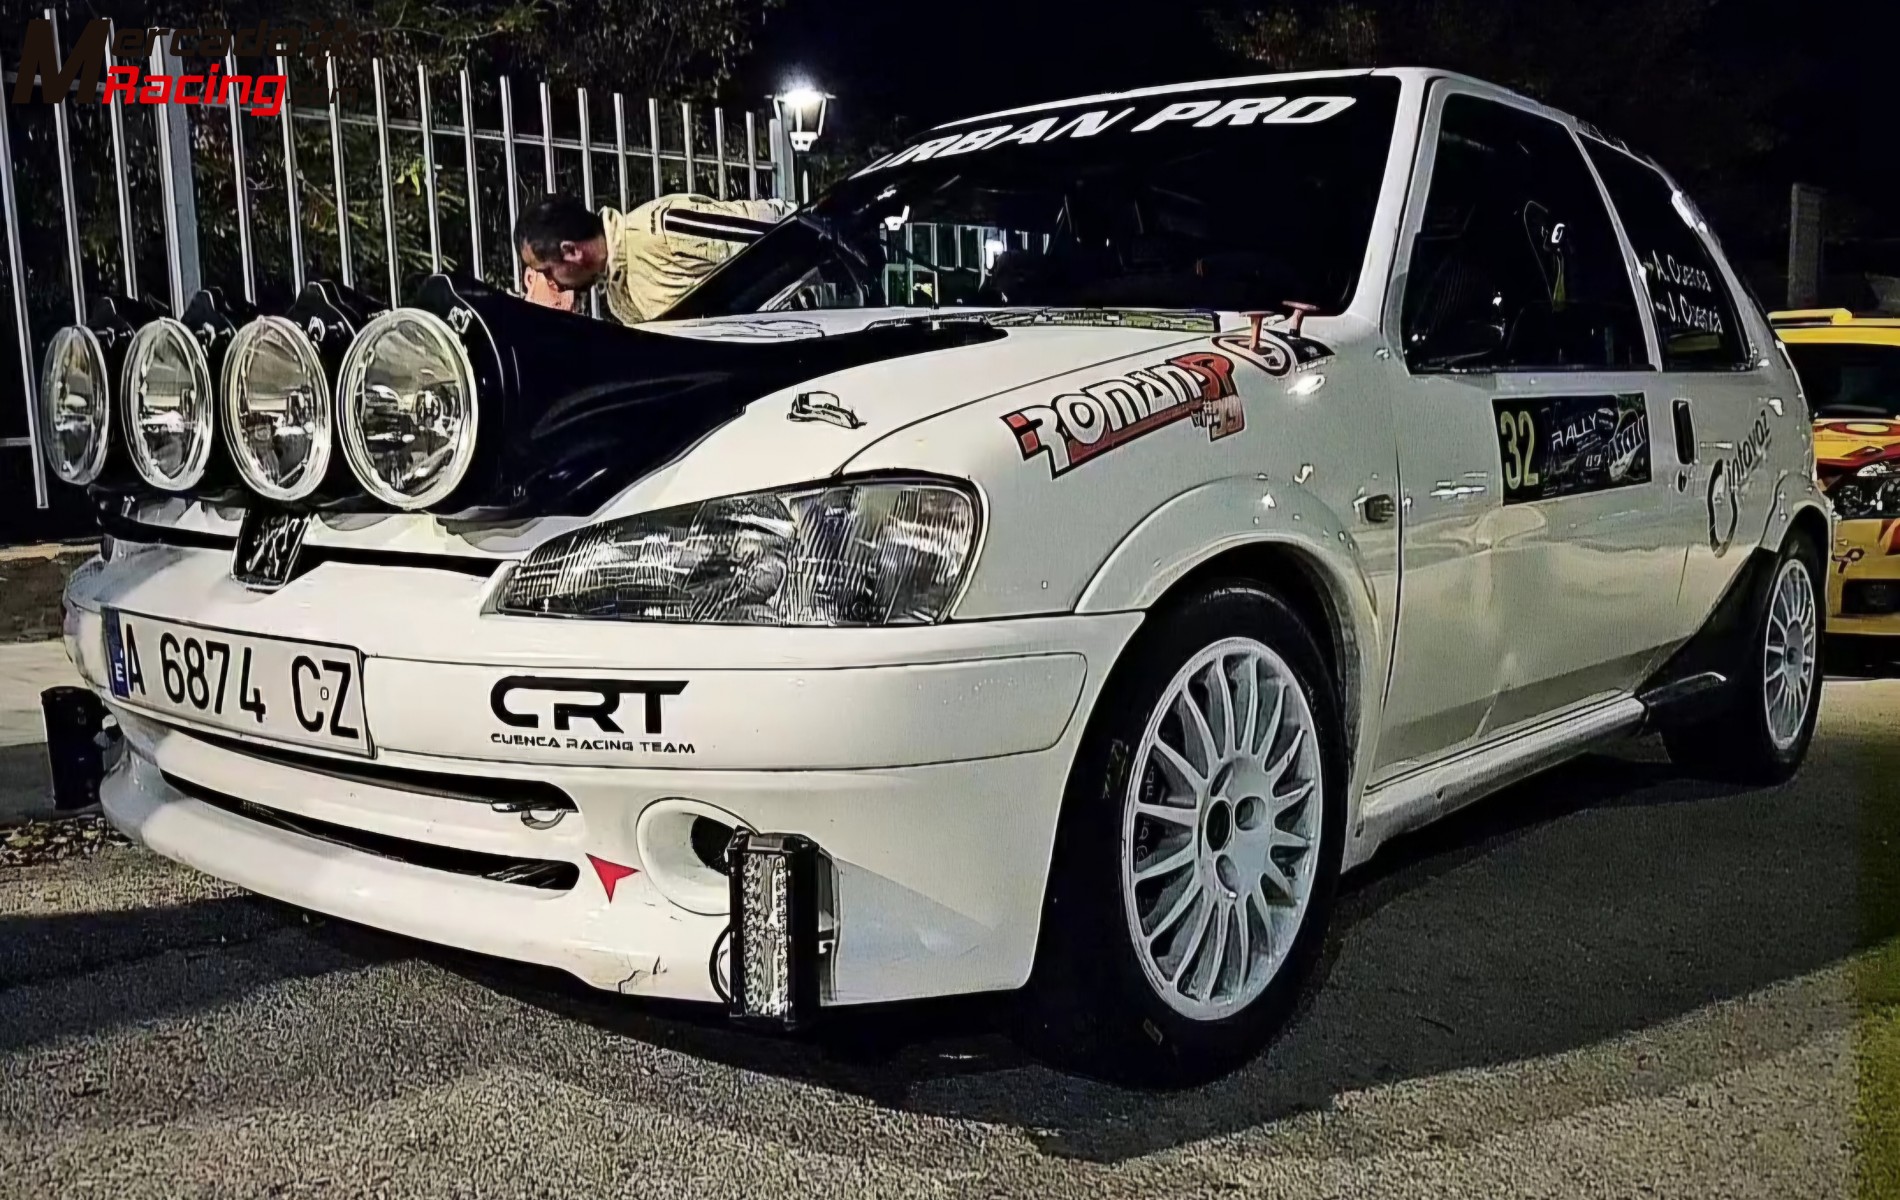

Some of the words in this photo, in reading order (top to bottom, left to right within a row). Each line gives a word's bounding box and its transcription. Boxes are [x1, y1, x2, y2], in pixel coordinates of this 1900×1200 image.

[1132, 96, 1357, 133] PRO
[1501, 410, 1539, 489] 32
[125, 623, 147, 696] A
[160, 632, 266, 723] 6874
[291, 655, 359, 739] CZ
[490, 675, 690, 734] CRT
[490, 732, 561, 749] CUENCA
[566, 738, 634, 751] RACING
[640, 741, 696, 754] TEAM
